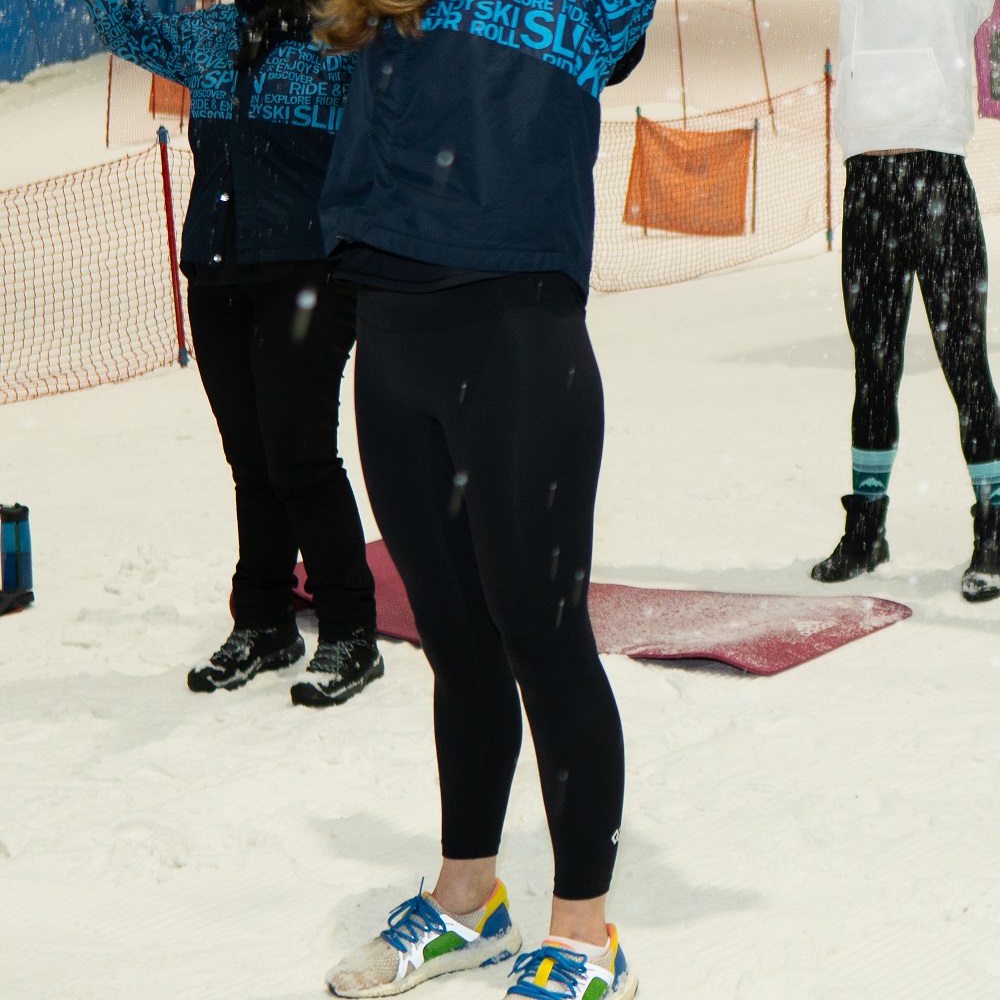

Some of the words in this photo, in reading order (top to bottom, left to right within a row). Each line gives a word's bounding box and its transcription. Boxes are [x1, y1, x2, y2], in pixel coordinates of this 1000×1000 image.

[473, 1, 521, 29] SKI
[469, 20, 520, 49] ROLL
[289, 81, 328, 96] RIDE
[264, 94, 312, 105] EXPLORE
[262, 105, 290, 120] SKI
